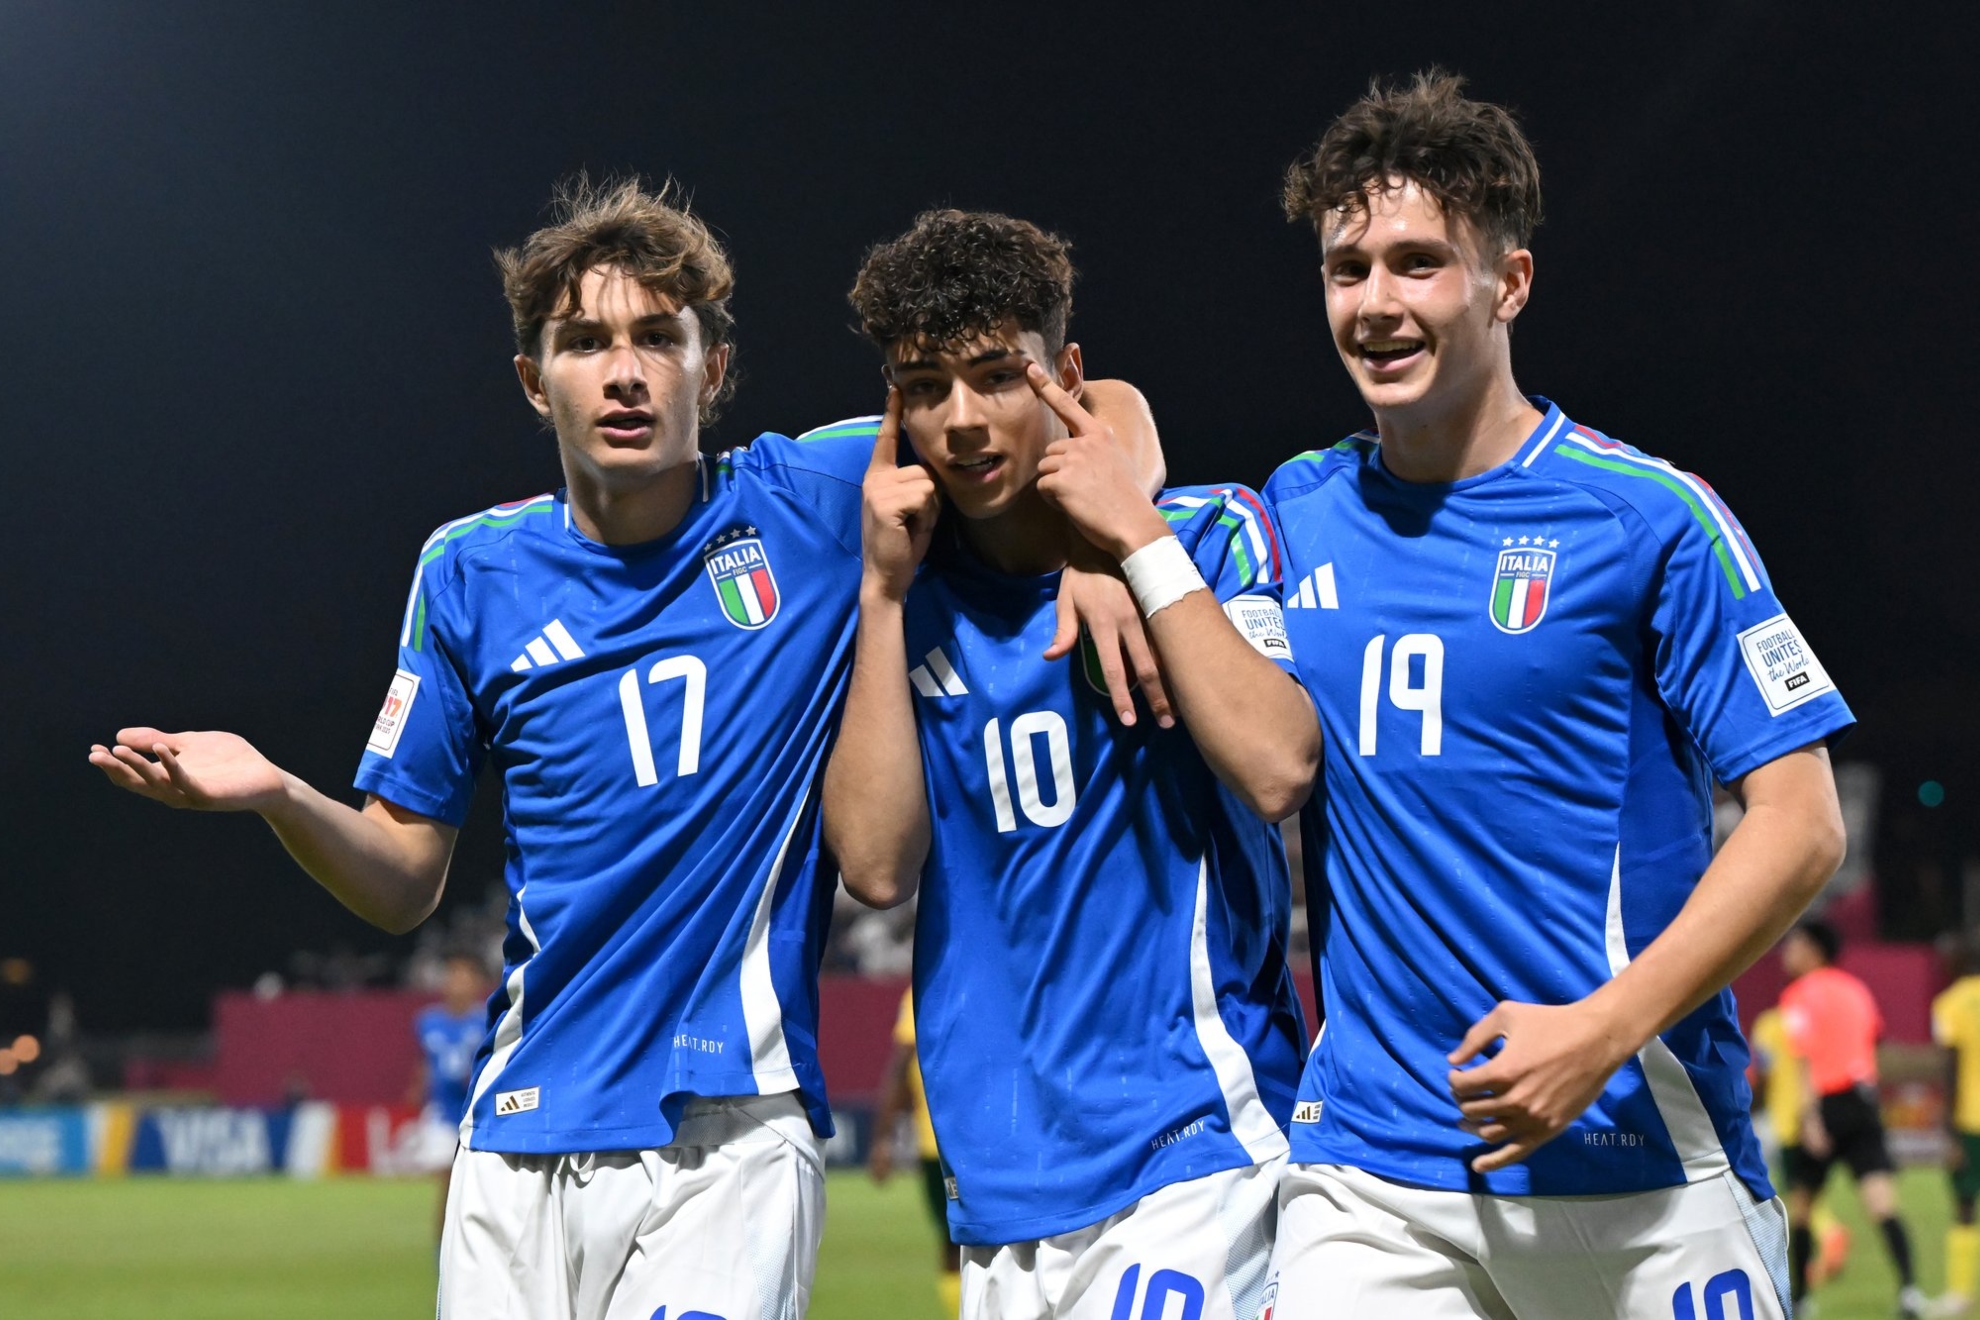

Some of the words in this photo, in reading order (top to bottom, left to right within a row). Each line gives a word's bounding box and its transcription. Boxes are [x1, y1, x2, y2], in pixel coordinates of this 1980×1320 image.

[710, 546, 761, 574] ITALIA
[1501, 555, 1548, 571] ITALIA
[1762, 639, 1802, 667] UNITES
[1768, 666, 1785, 682] the
[1788, 674, 1808, 688] FIFA
[1359, 633, 1444, 756] 19
[619, 655, 706, 787] 17
[984, 710, 1076, 833] 10
[1151, 1120, 1204, 1150] HEAT.RDY
[1584, 1133, 1644, 1146] HEAT.RDY
